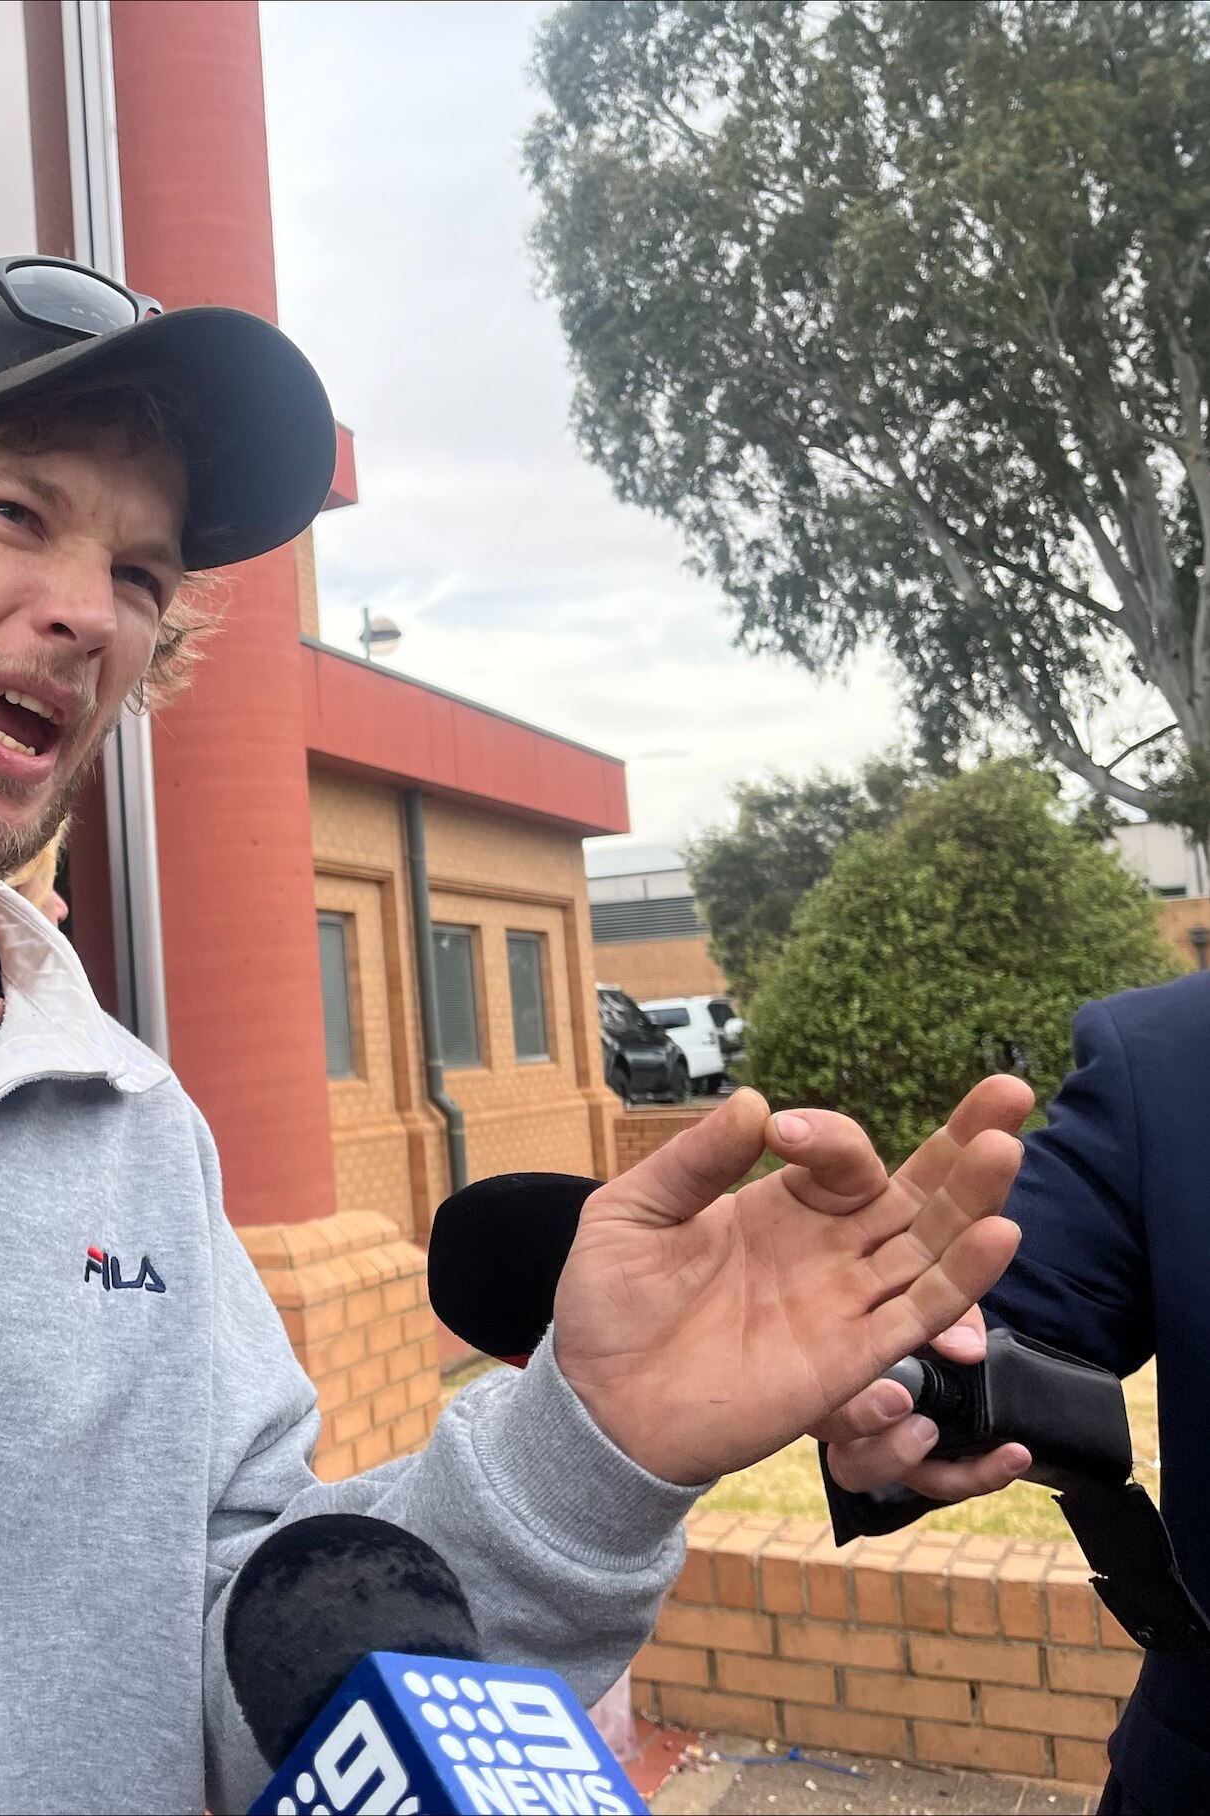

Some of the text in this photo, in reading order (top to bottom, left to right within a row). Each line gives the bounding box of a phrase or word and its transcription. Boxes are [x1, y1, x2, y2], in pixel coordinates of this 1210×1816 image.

[84, 1246, 166, 1293] FILA
[313, 1699, 408, 1815] 9
[485, 1680, 601, 1771] 9
[452, 1764, 633, 1815] NEWS
